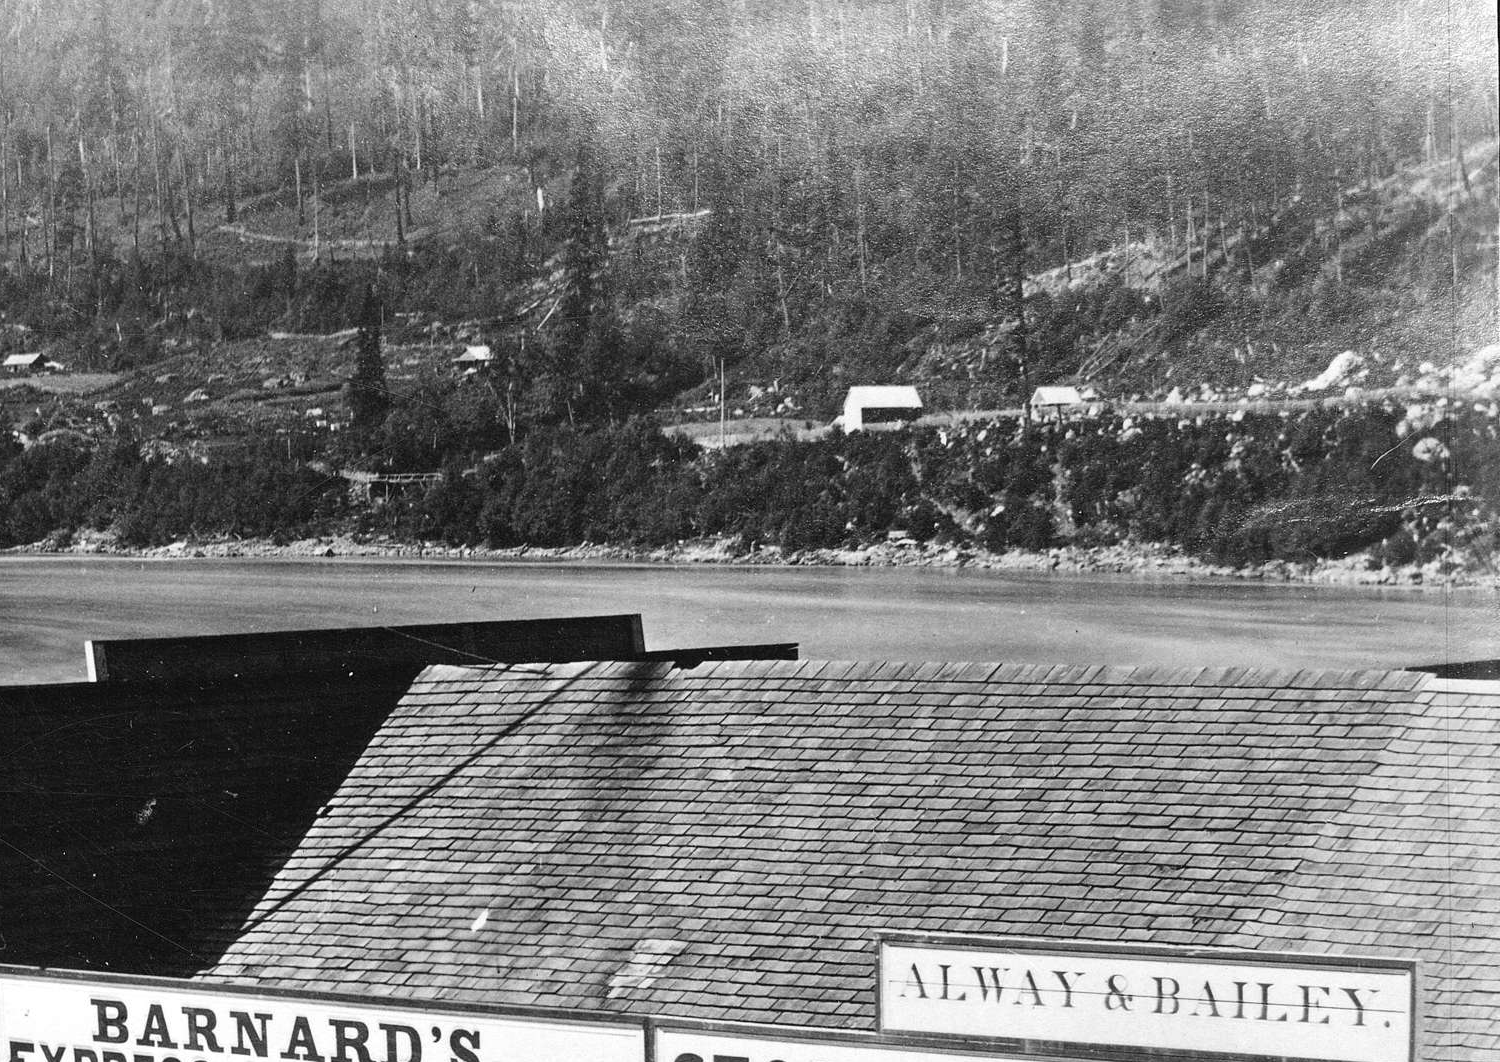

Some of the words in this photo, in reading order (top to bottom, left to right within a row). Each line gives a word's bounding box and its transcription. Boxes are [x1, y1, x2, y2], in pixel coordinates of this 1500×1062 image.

[899, 960, 1086, 1010] ALWAY
[1104, 973, 1138, 1012] &
[1153, 975, 1393, 1030] BAILEY.
